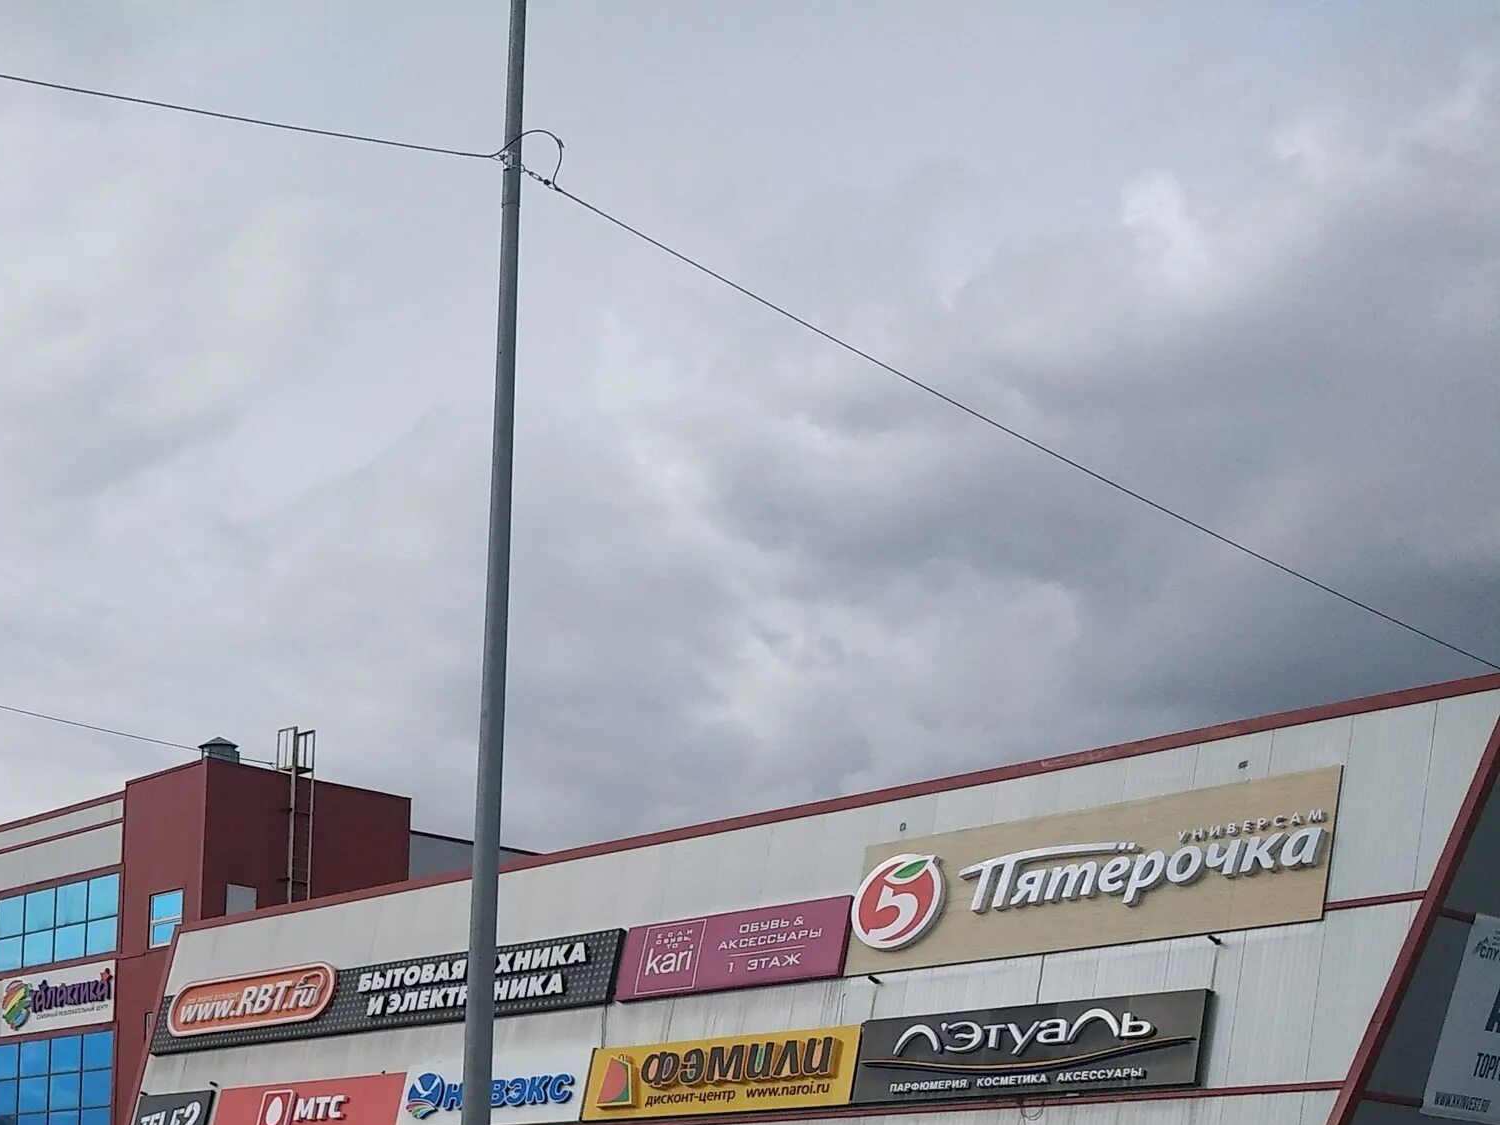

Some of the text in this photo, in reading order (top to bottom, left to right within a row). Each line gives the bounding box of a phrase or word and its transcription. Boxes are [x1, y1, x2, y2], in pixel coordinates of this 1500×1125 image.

[1178, 808, 1324, 842] УНИВЕРСАМ
[717, 927, 824, 951] АКСЕССУАРЫ
[738, 916, 805, 934] ОБУВЬ &
[357, 941, 587, 993] БЫТОВАЯ ХНИКА
[644, 944, 694, 976] kari
[727, 952, 802, 973] 1 ЭТАЖ
[179, 980, 319, 1024] www.RBT.ru
[366, 972, 564, 1016] И ЭЛЕКТРНИКА
[889, 1067, 1143, 1094] ПАРФЮМЕРИЯ КОСМЕТИКА АКСЕССУАРЫ
[1473, 1052, 1500, 1081] ТОРГ
[443, 1073, 574, 1111] НВЭКС
[645, 1081, 830, 1107] дисконт-центр www.naroi.ru
[293, 1094, 348, 1121] МТС
